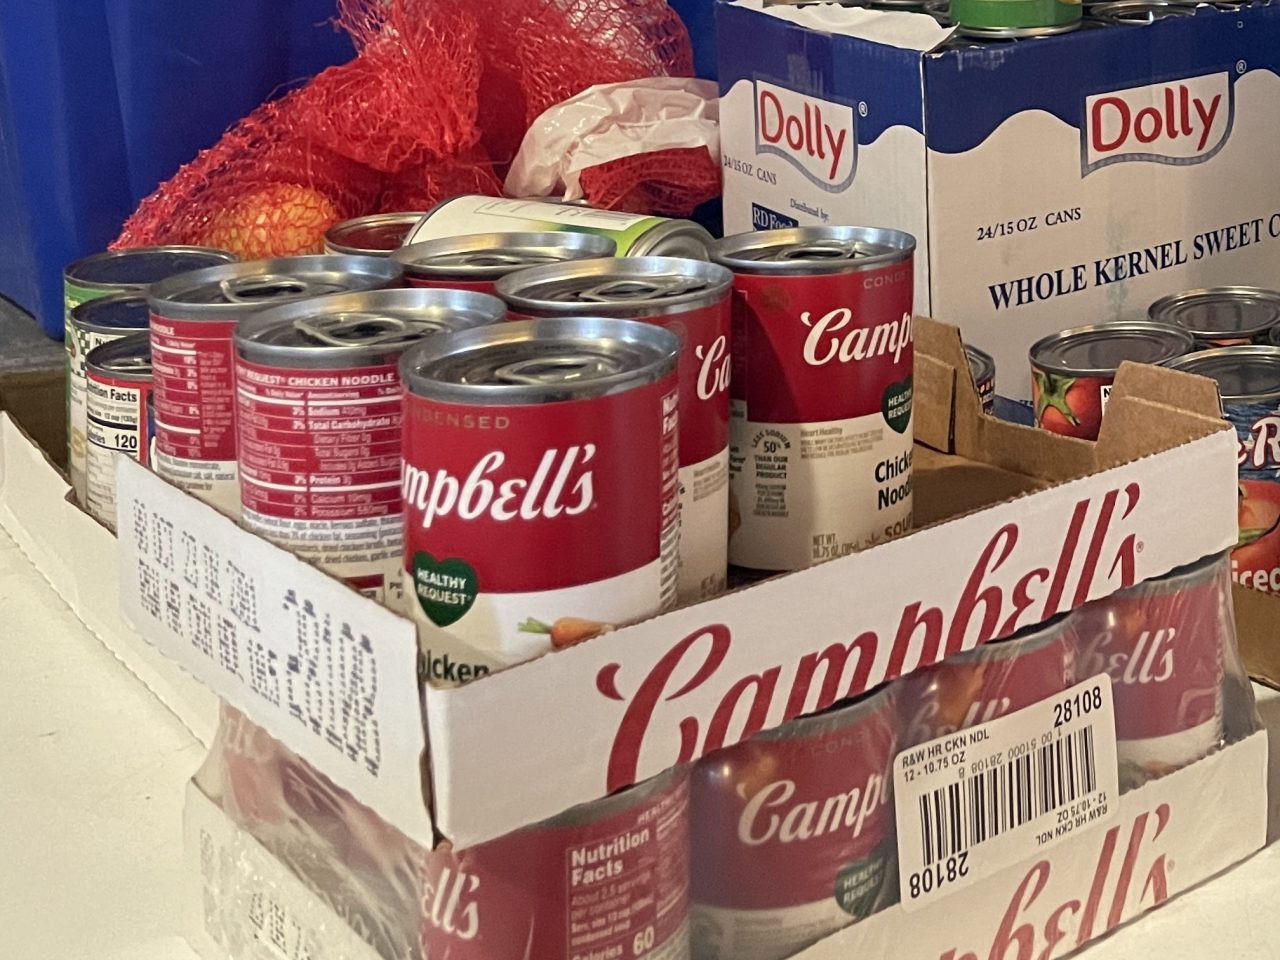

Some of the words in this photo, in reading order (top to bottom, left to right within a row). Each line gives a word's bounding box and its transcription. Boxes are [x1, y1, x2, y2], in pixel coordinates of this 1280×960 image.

[1092, 84, 1222, 153] Dolly
[760, 90, 847, 180] Dolly
[756, 167, 777, 186] CANS
[753, 206, 769, 227] RD
[976, 221, 1014, 241] 24/15
[1016, 216, 1038, 233] OZ
[1045, 207, 1082, 227] CANS
[988, 264, 1088, 311] WHOLE
[1094, 239, 1187, 287] KERNEL
[1193, 218, 1264, 260] SWEET
[288, 376, 339, 386] CHICKEN
[341, 372, 395, 386] NOODLE
[110, 388, 138, 403] Facts
[308, 407, 340, 417] Sodium
[308, 420, 330, 430] Total
[331, 416, 391, 430] Carbohydrate
[412, 406, 511, 430] NDENSED
[114, 434, 138, 449] 120
[309, 475, 341, 485] Protein
[402, 442, 598, 529] mpbell's
[878, 474, 912, 511] Nood
[884, 512, 911, 538] SOU
[416, 567, 467, 591] HEALTHY
[417, 583, 467, 605] REQUEST
[596, 481, 1140, 795] Campbell's
[1053, 685, 1103, 728] 28108
[901, 749, 926, 770] R&W
[927, 744, 943, 757] HR
[944, 734, 968, 752] CKN
[969, 728, 990, 746] NDL
[903, 769, 915, 784] 12
[924, 757, 949, 777] 10.75
[951, 750, 967, 766] OZ
[970, 752, 1003, 774] 28108
[1056, 809, 1069, 823] OZ
[1069, 796, 1091, 817] 10.75
[1088, 804, 1108, 822] R&W
[1054, 820, 1074, 837] CKN
[1074, 813, 1087, 829] HR
[571, 828, 650, 868] Nutrition
[1035, 828, 1054, 846] NDL
[571, 859, 624, 887] Facts
[909, 850, 970, 899] 28108
[420, 865, 481, 940] ell's
[632, 925, 656, 957] 60
